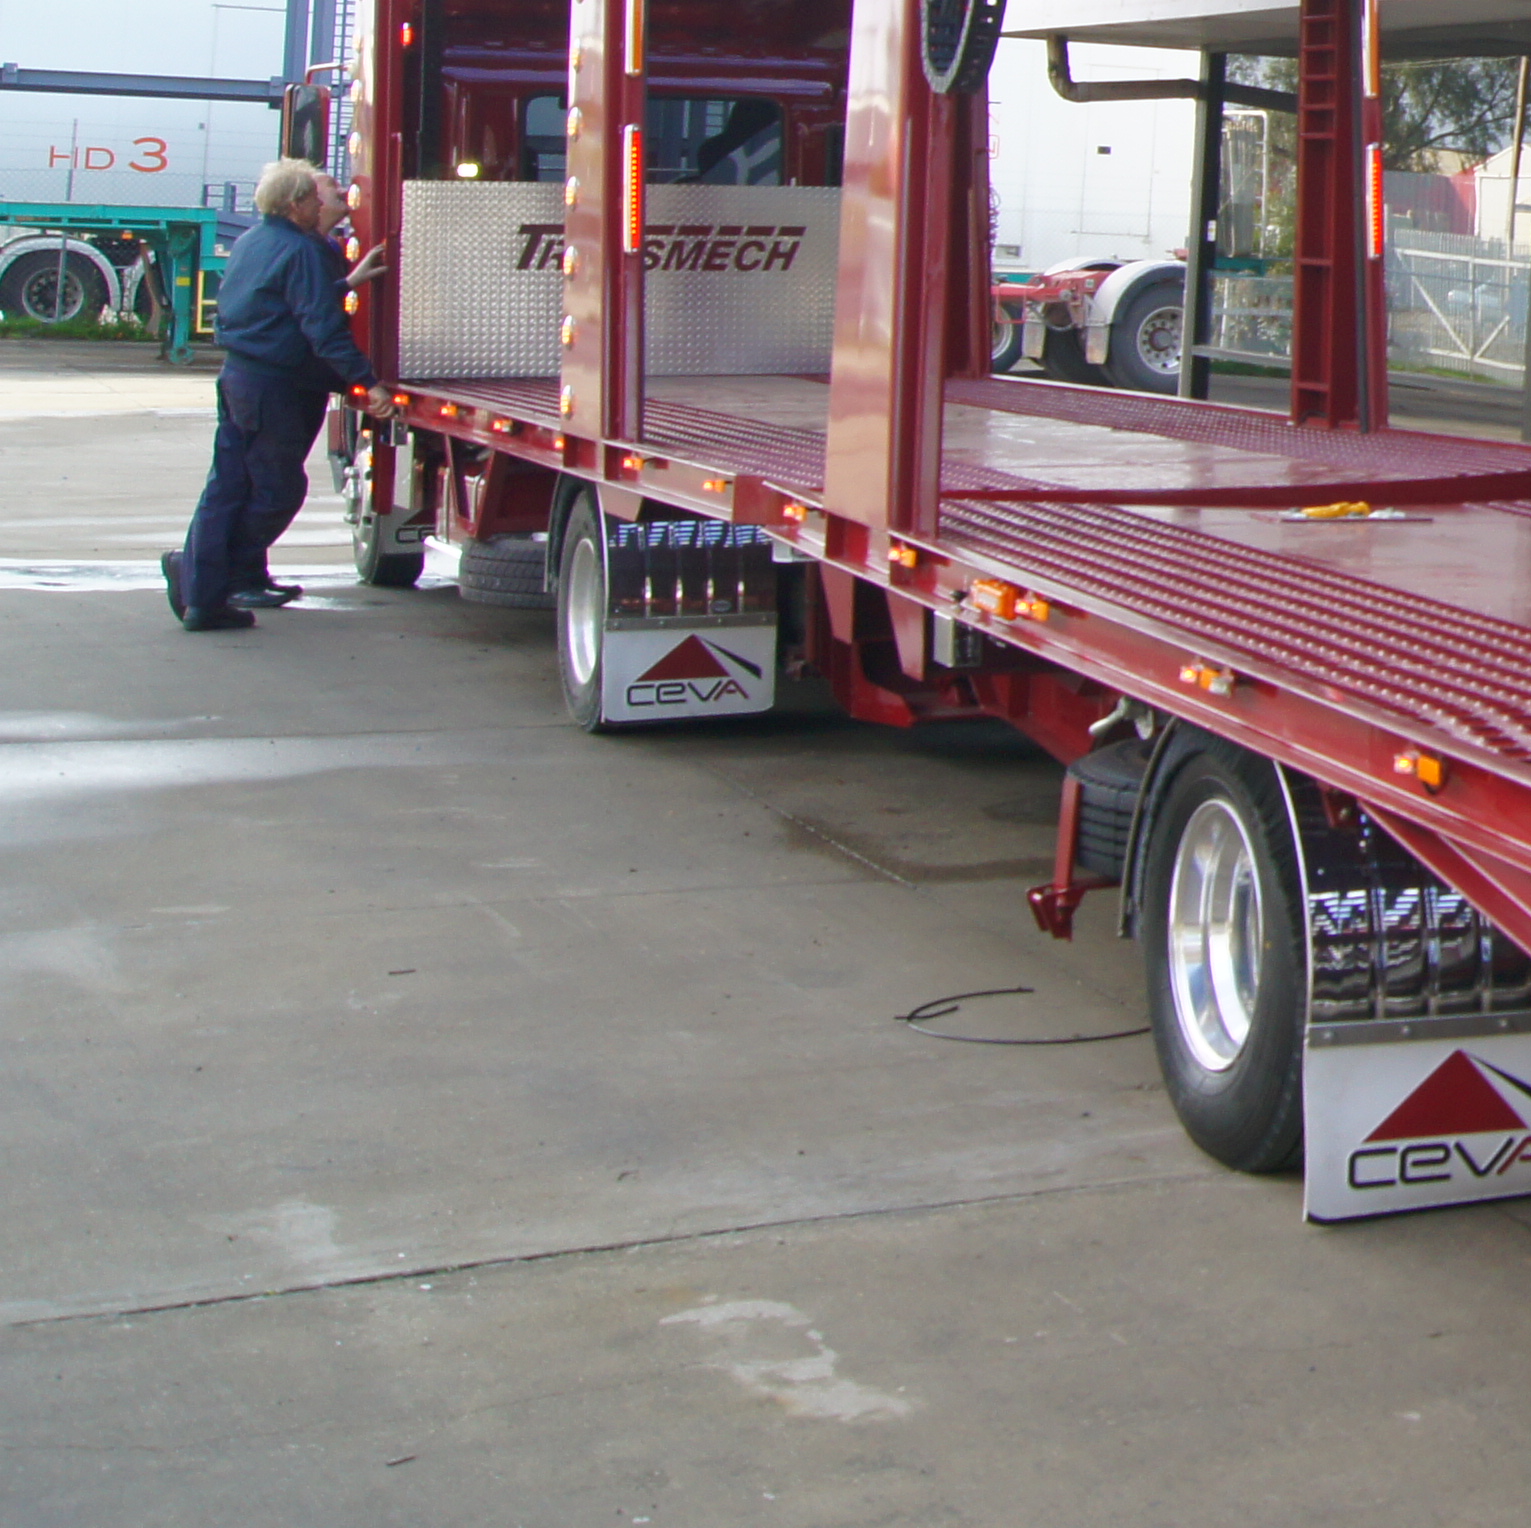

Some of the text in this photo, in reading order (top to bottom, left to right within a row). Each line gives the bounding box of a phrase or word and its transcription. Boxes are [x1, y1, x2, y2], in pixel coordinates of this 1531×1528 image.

[49, 137, 169, 173] HD 3
[515, 224, 807, 270] TRSMECH
